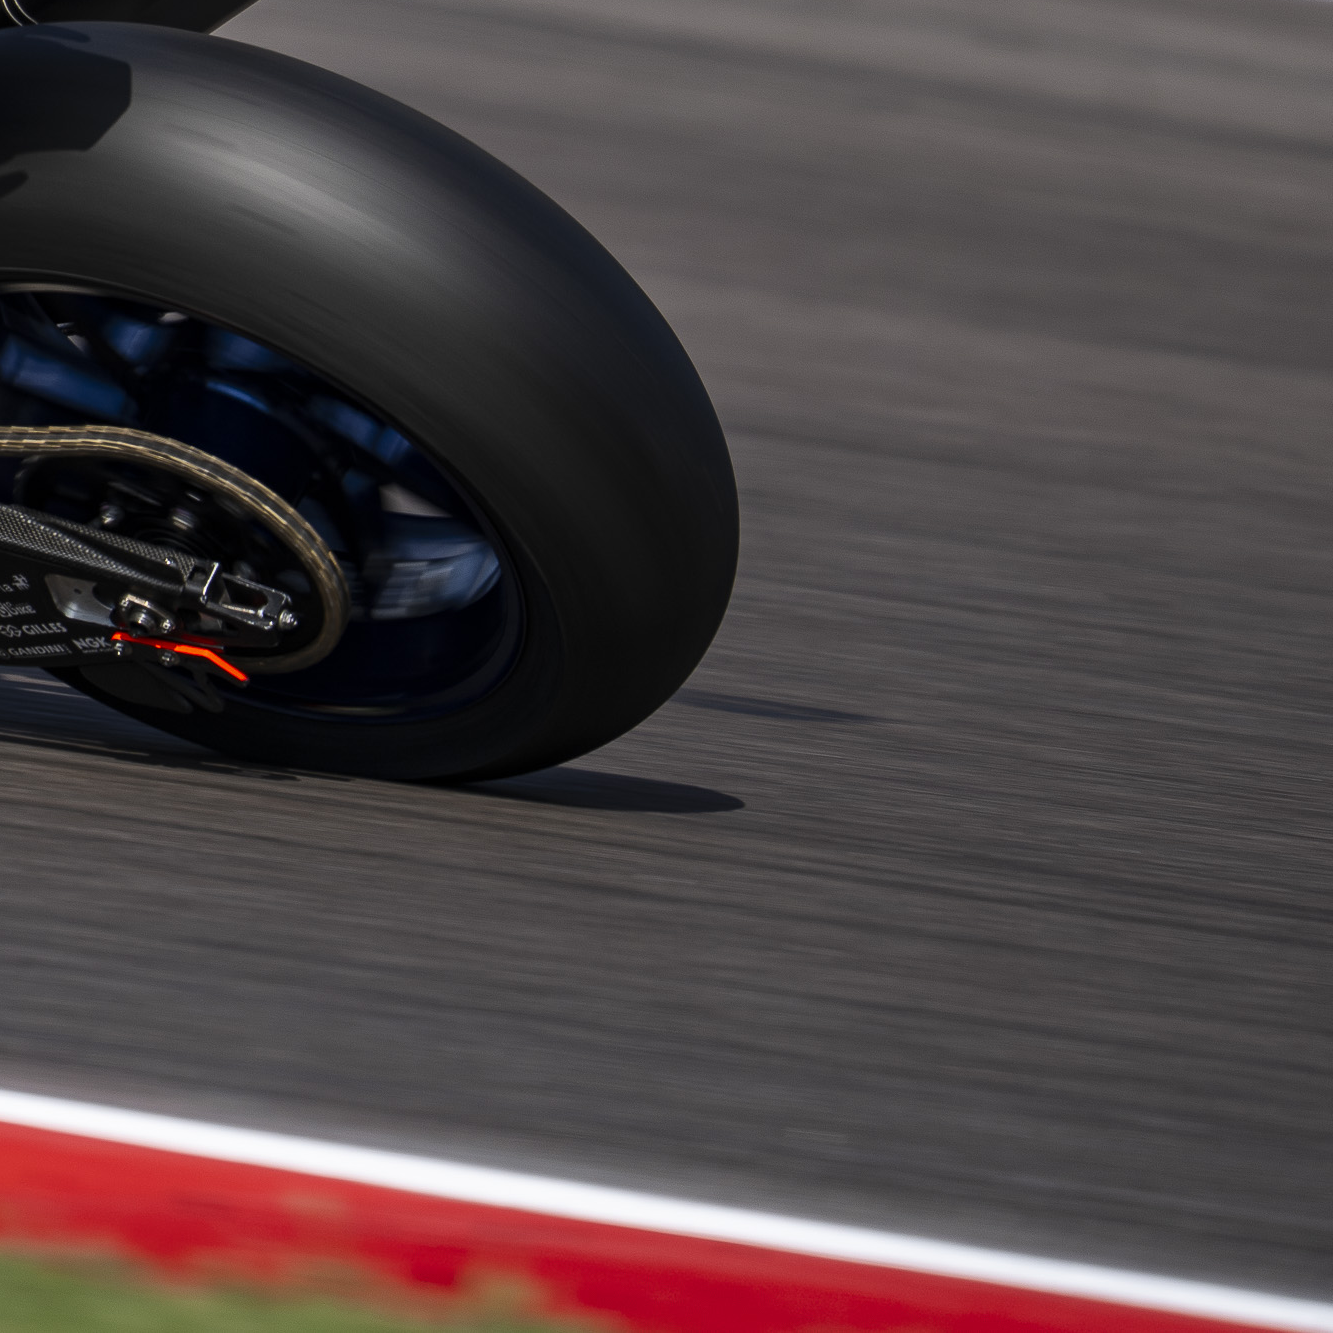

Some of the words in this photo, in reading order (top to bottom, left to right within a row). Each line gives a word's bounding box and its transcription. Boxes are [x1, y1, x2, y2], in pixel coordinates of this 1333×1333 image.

[21, 622, 68, 636] GILLES
[8, 643, 66, 657] GANDINI
[71, 636, 112, 650] NGK
